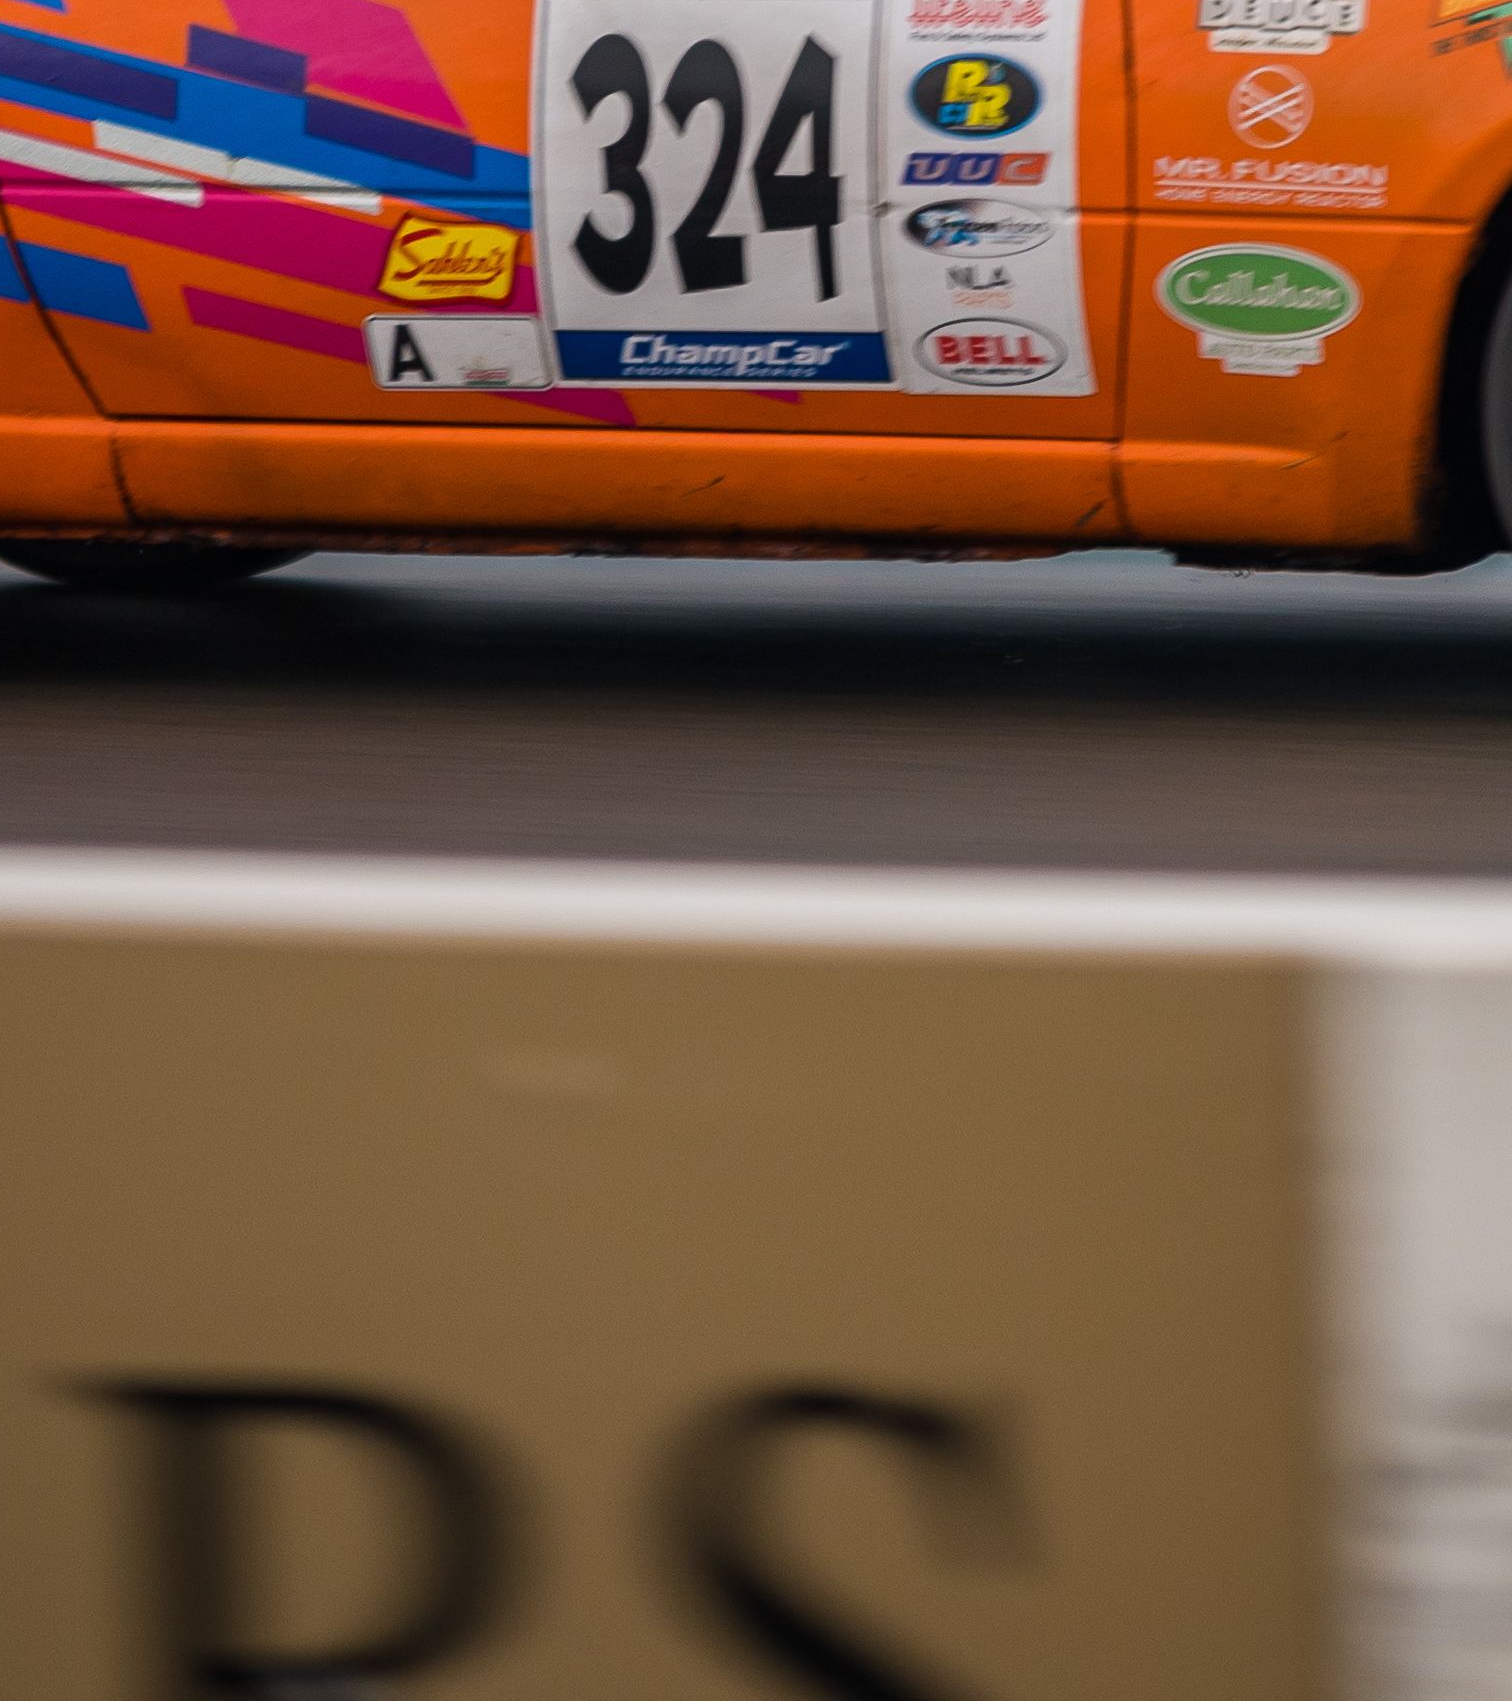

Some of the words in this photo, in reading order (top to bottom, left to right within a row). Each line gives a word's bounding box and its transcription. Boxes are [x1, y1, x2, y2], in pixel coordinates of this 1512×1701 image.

[568, 32, 843, 303] 324
[1231, 158, 1388, 187] FUSION
[390, 324, 434, 382] A
[619, 334, 848, 376] ChampCar
[934, 335, 1051, 365] BELL
